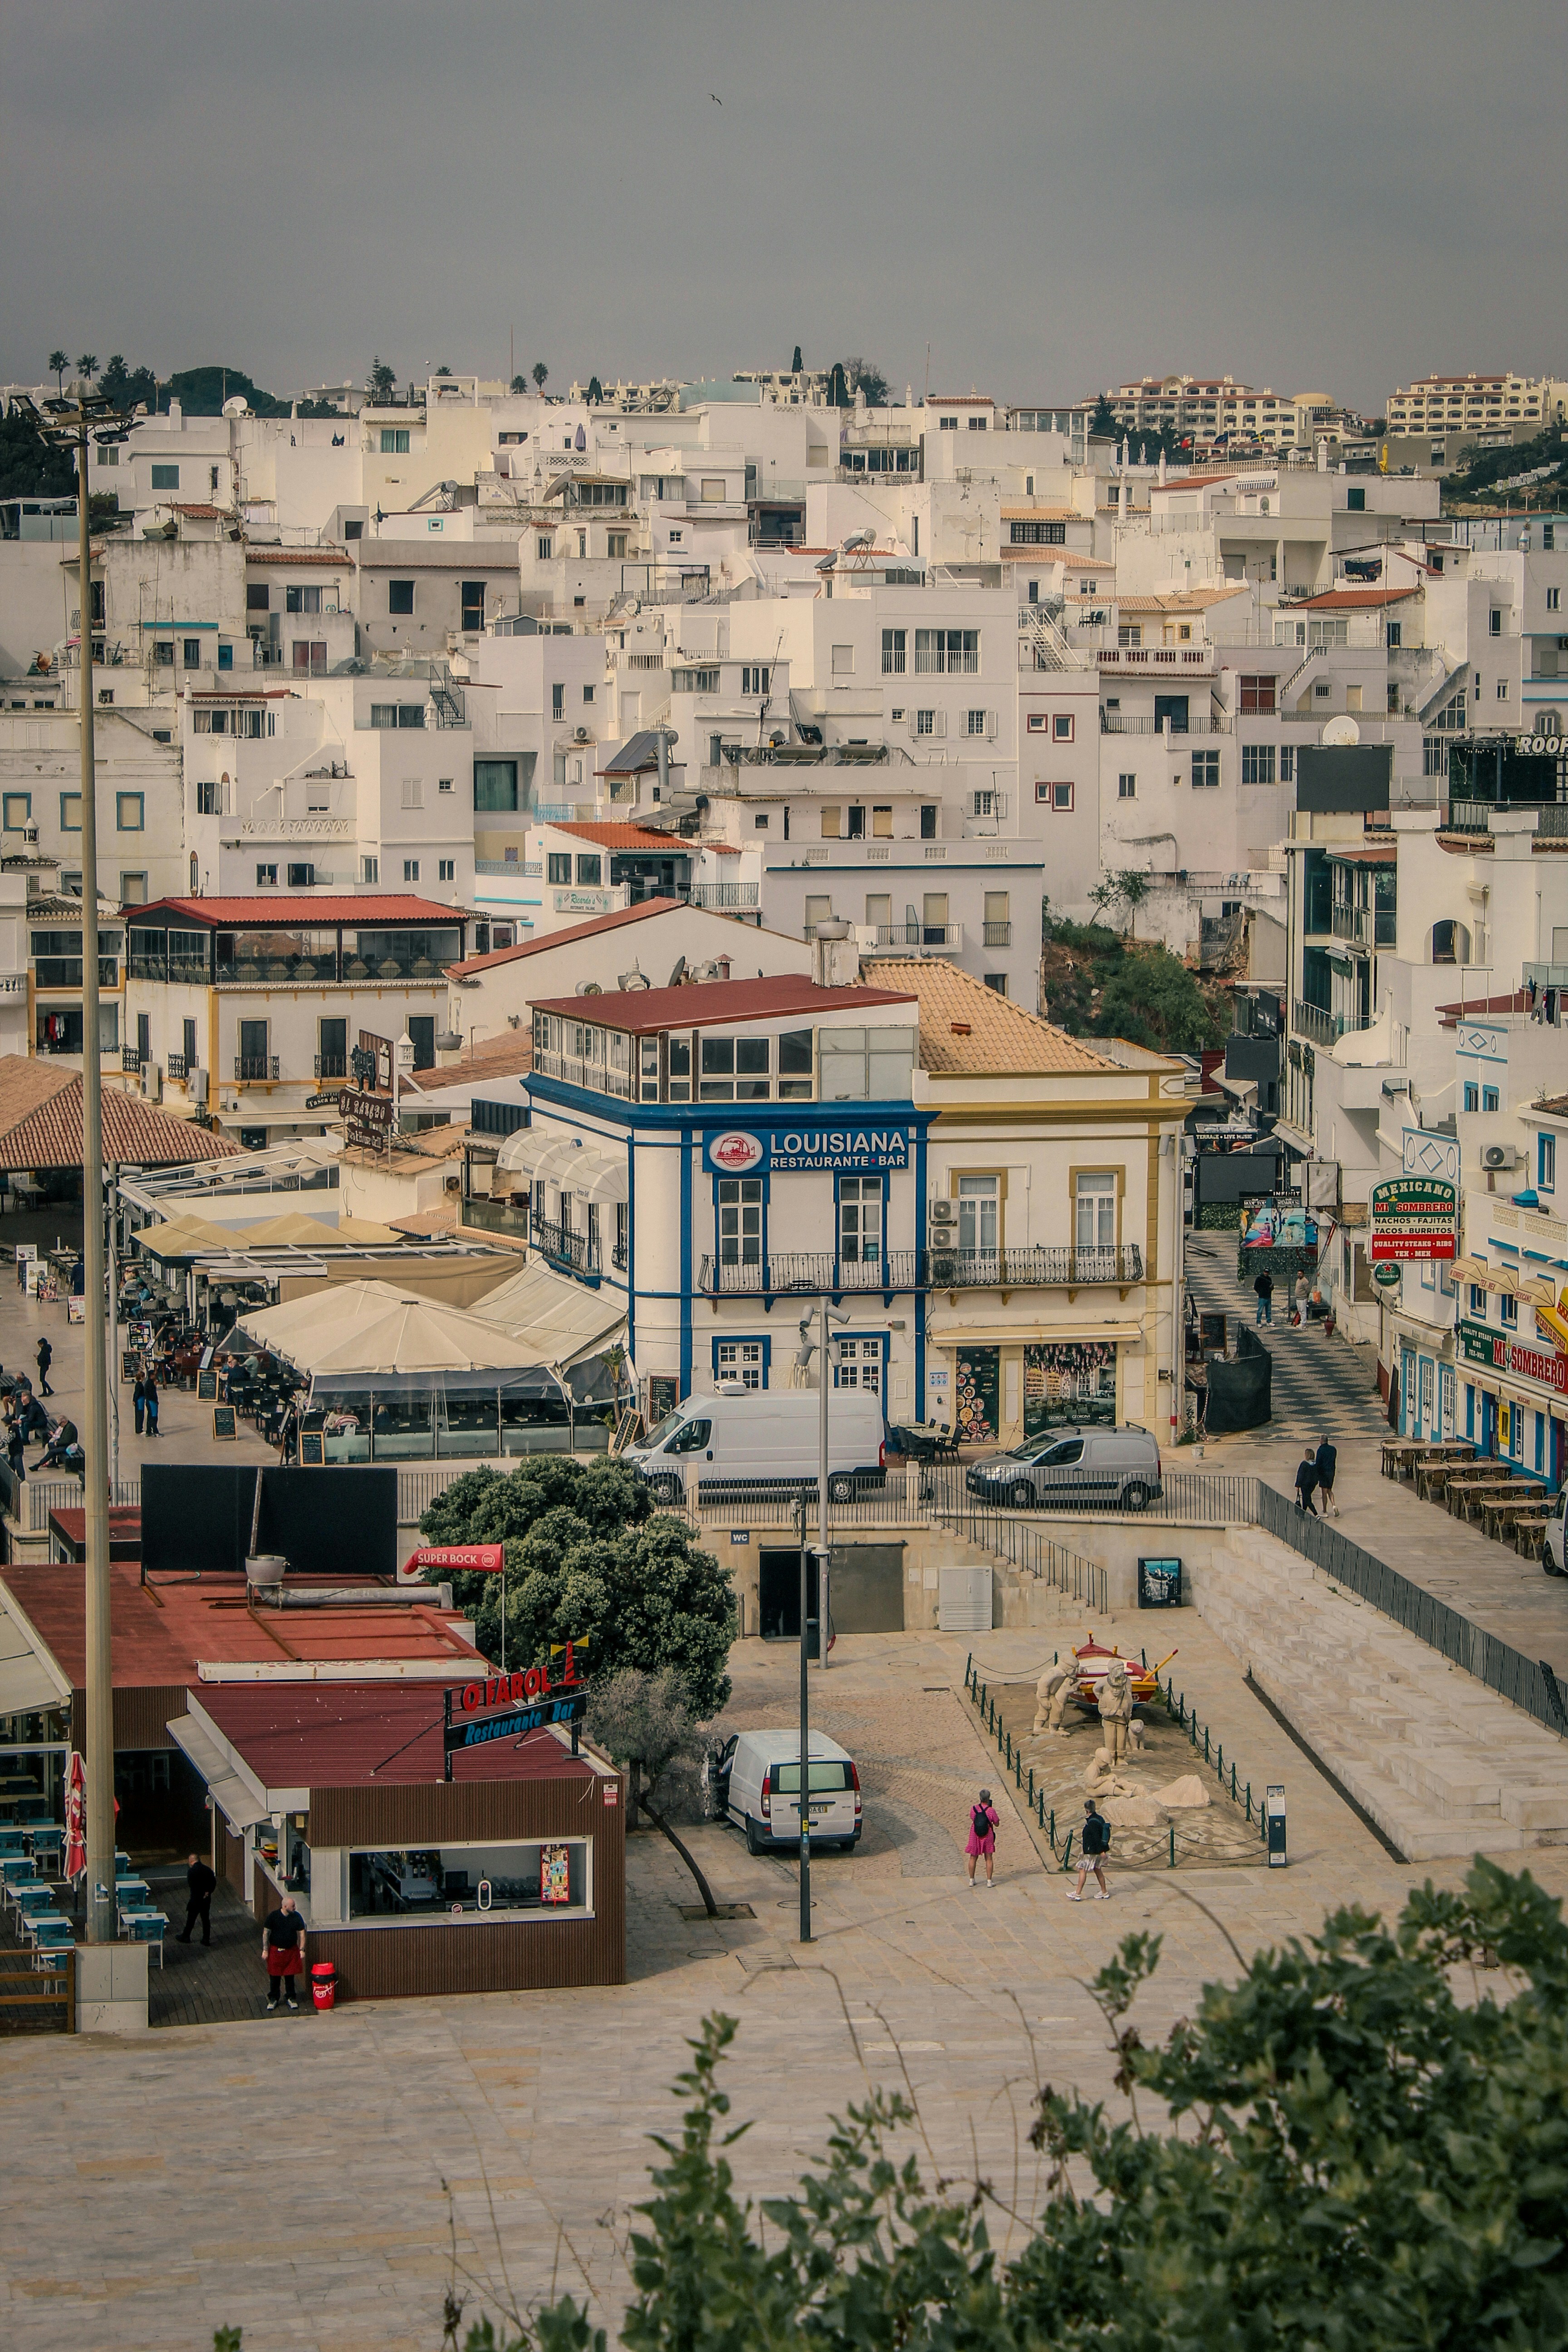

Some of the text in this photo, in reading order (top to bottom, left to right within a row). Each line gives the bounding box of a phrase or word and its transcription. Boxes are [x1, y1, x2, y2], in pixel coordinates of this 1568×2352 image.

[571, 893, 595, 904] Ricardo's
[308, 1098, 328, 1107] Tasca
[354, 1100, 385, 1119] RANCHO
[771, 1132, 905, 1154] LOUISIANA
[771, 1155, 905, 1168] RESTAURANTE BAR
[1377, 1181, 1452, 1200] MEXICANO
[1375, 1202, 1453, 1212] MI SOMBRERO
[1515, 1291, 1532, 1303] MEXICANO
[1462, 1327, 1492, 1342] QUALITY STEAKS
[1473, 1340, 1481, 1348] RIBS
[1557, 1336, 1565, 1352] CASA
[1469, 1349, 1485, 1360] TEX-MEX
[1493, 1338, 1564, 1389] MI SOMBRERO
[1517, 1396, 1530, 1405] MEXICANO
[418, 1553, 477, 1564] SUPER BOCK
[462, 1665, 552, 1712] O FAROL
[465, 1702, 575, 1745] Restaurante Bar
